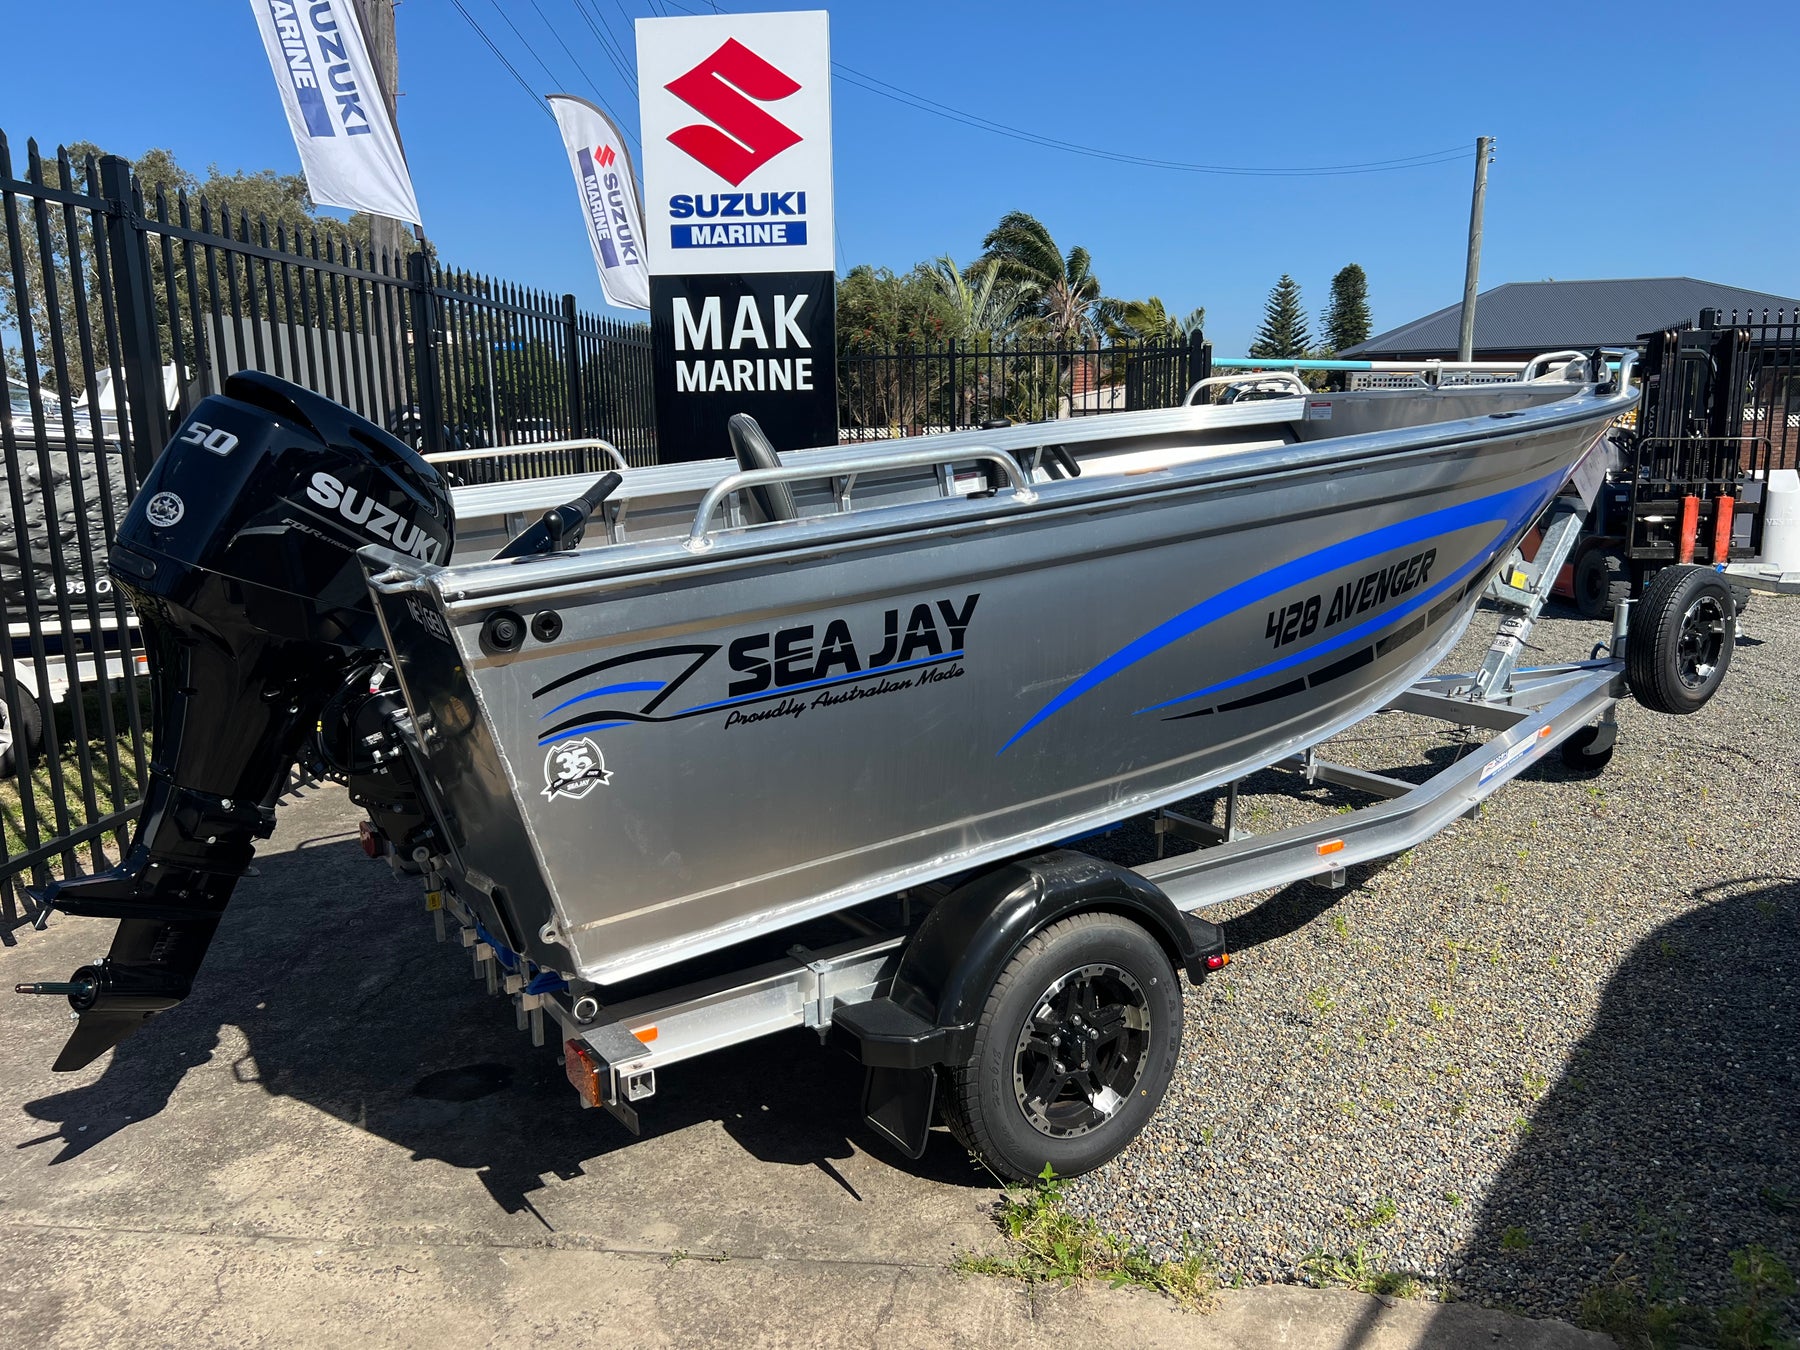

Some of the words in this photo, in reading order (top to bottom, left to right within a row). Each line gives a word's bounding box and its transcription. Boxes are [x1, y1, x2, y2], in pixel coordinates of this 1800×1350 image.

[271, 0, 317, 89] ARINE
[307, 0, 371, 136] UZUKI
[584, 174, 611, 241] MARINE
[603, 172, 639, 266] SUZUKI
[669, 191, 807, 218] SUZUKI
[691, 224, 787, 245] MARINE
[672, 294, 812, 351] MAK
[675, 357, 814, 392] MARINE
[180, 421, 239, 456] 50
[1646, 404, 1656, 453] TOYOTA
[306, 471, 442, 565] SUZUKI
[1264, 594, 1322, 649] 428
[1323, 547, 1437, 629] AVENGER
[728, 618, 862, 698] SEA
[869, 593, 981, 668] JAY
[724, 698, 807, 730] Proudly
[811, 678, 912, 710] Australian
[915, 662, 965, 687] Made
[555, 747, 593, 780] 35
